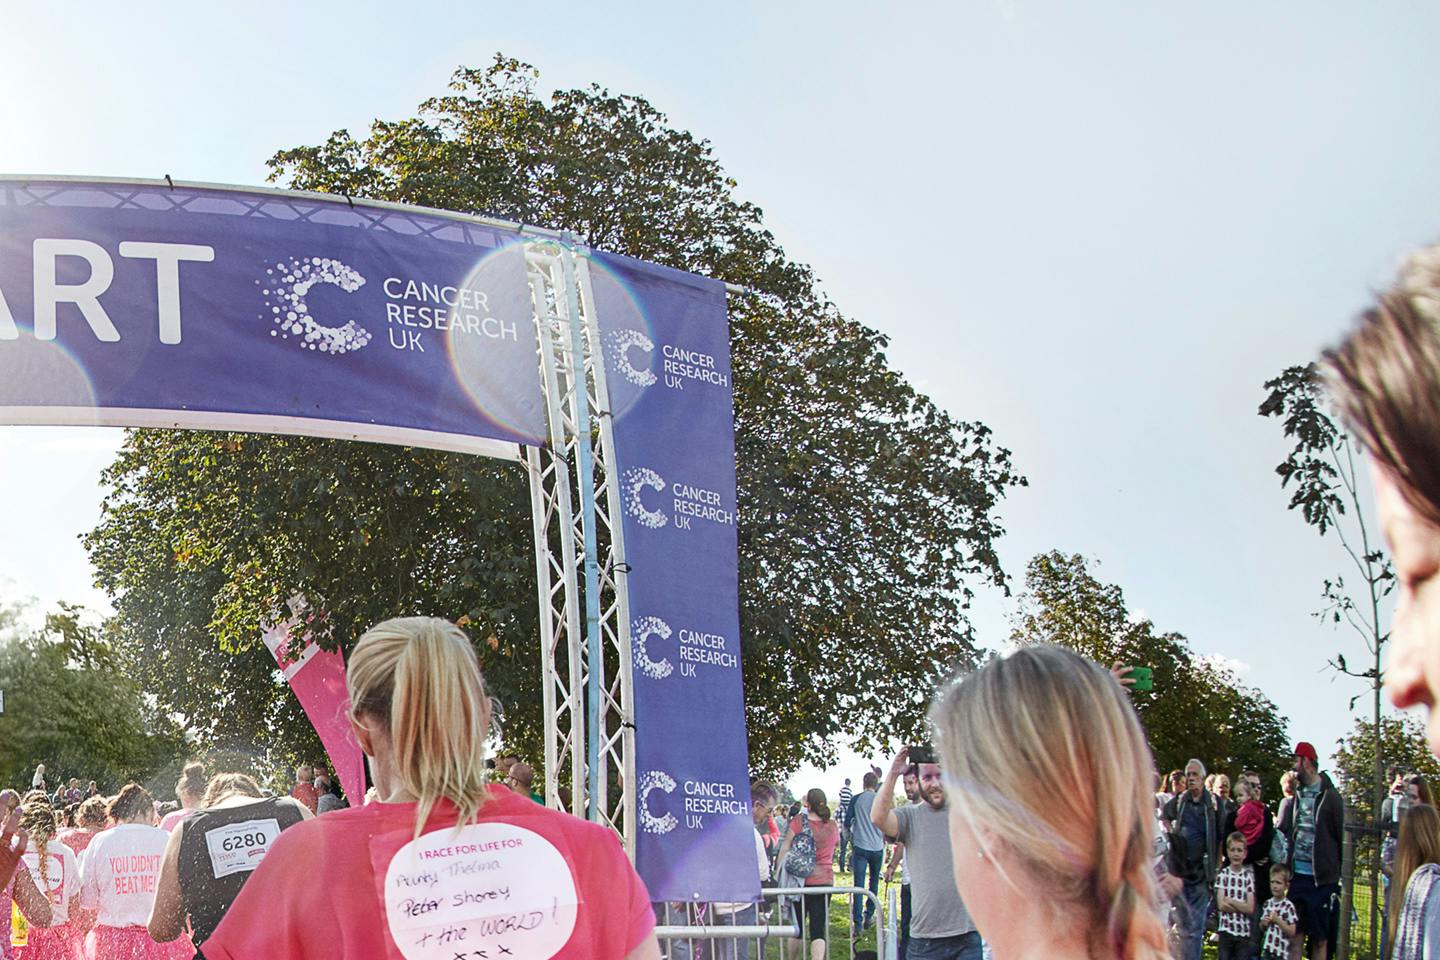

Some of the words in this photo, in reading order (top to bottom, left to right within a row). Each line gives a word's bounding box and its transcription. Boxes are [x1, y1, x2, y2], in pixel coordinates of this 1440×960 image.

[383, 277, 489, 312] CANCER
[386, 303, 517, 341] RESEARCH
[389, 327, 424, 352] UK
[662, 345, 715, 369] CANCER
[664, 359, 728, 387] RESEARCH
[664, 375, 683, 390] UK
[672, 483, 721, 507] CANCER
[674, 499, 733, 525] RESEARCH
[674, 514, 691, 530] UK
[679, 629, 725, 650] CANCER
[680, 646, 737, 669] RESEARCH
[680, 662, 697, 678] UK
[684, 780, 734, 798] CANCER
[685, 798, 748, 815] RESEARCH
[686, 815, 703, 829] UK
[223, 832, 266, 851] 6280
[425, 848, 452, 859] RACE
[456, 844, 477, 855] FOR
[479, 842, 500, 853] LIFE
[502, 838, 523, 849] FOR
[110, 856, 128, 874] YOU
[115, 875, 138, 895] BEAT
[437, 925, 467, 946] the
[481, 911, 543, 936] WORLD
